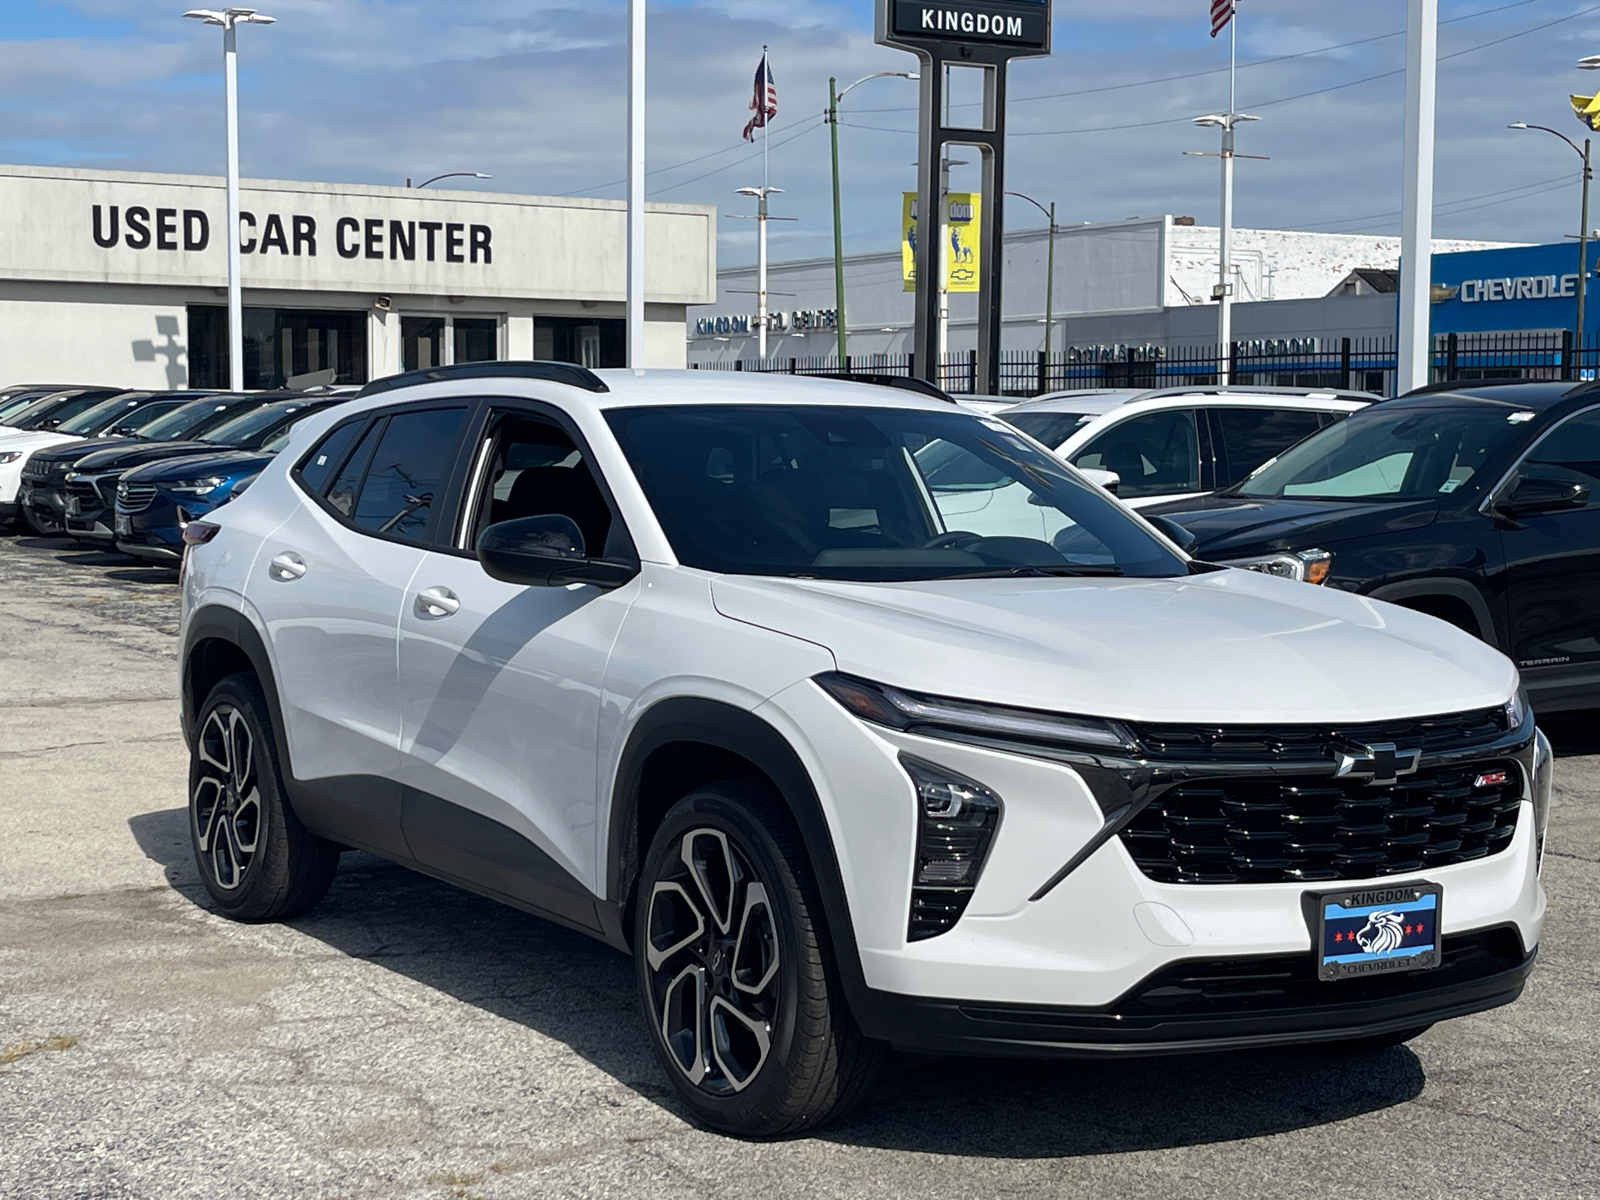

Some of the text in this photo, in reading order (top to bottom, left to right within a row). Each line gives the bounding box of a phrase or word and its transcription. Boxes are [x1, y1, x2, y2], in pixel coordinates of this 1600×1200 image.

[922, 9, 1022, 36] KINGDOM
[92, 205, 492, 264] USED CAR CENTER
[696, 314, 751, 335] KINGDOM
[1519, 656, 1570, 667] TERRAIN
[1351, 888, 1415, 906] KINGDOM
[1347, 958, 1411, 975] CHEVROLET
